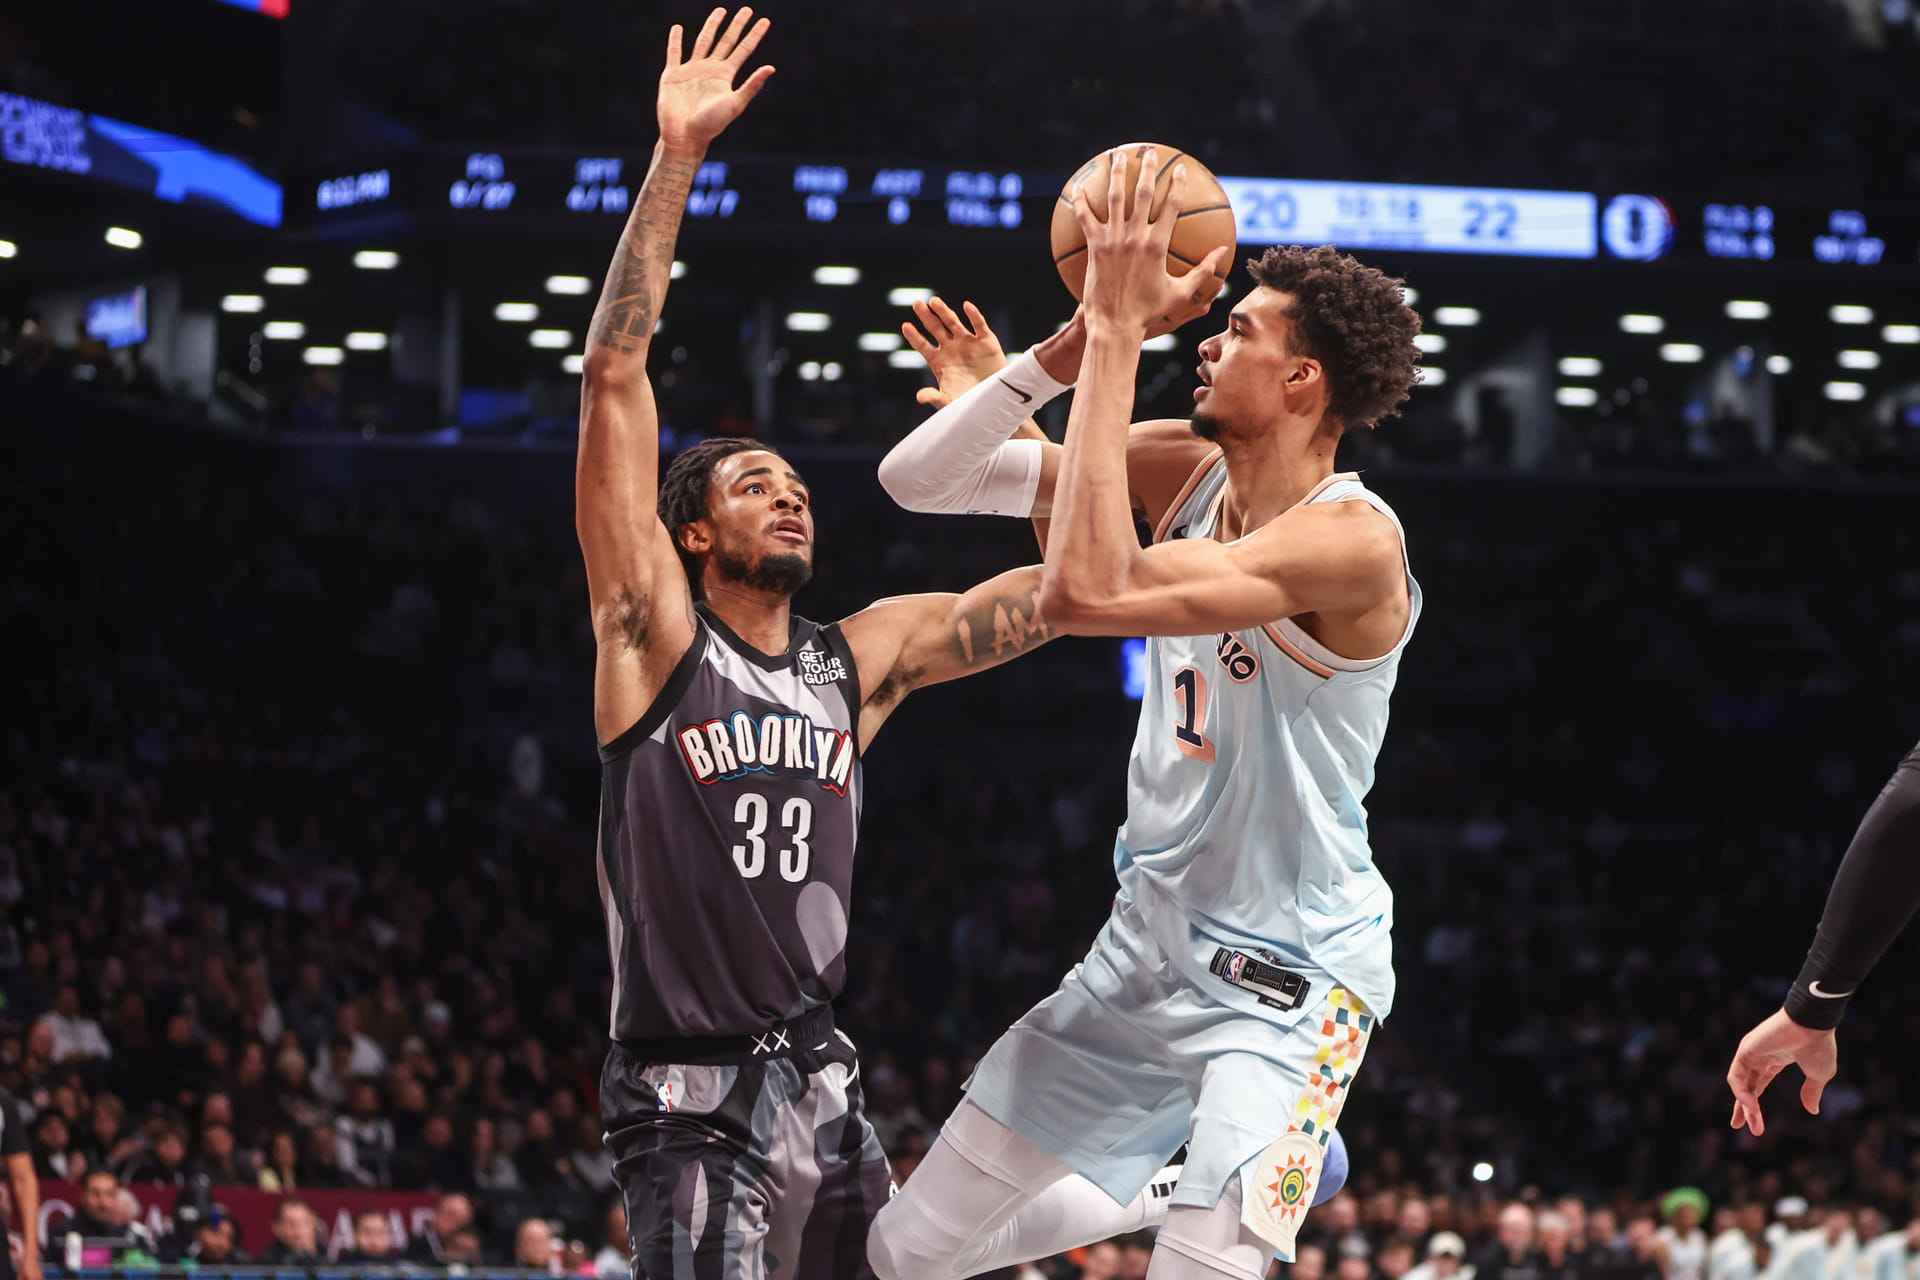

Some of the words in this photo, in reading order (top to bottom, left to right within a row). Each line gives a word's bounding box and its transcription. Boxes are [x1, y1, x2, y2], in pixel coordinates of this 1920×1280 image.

[1239, 191, 1298, 230] 20
[1461, 200, 1519, 239] 22
[799, 651, 825, 663] GET
[801, 657, 842, 674] YOUR
[804, 668, 848, 684] GUIDE
[1174, 666, 1207, 753] 1
[679, 711, 854, 791] BROOKLYN
[732, 793, 812, 883] 33
